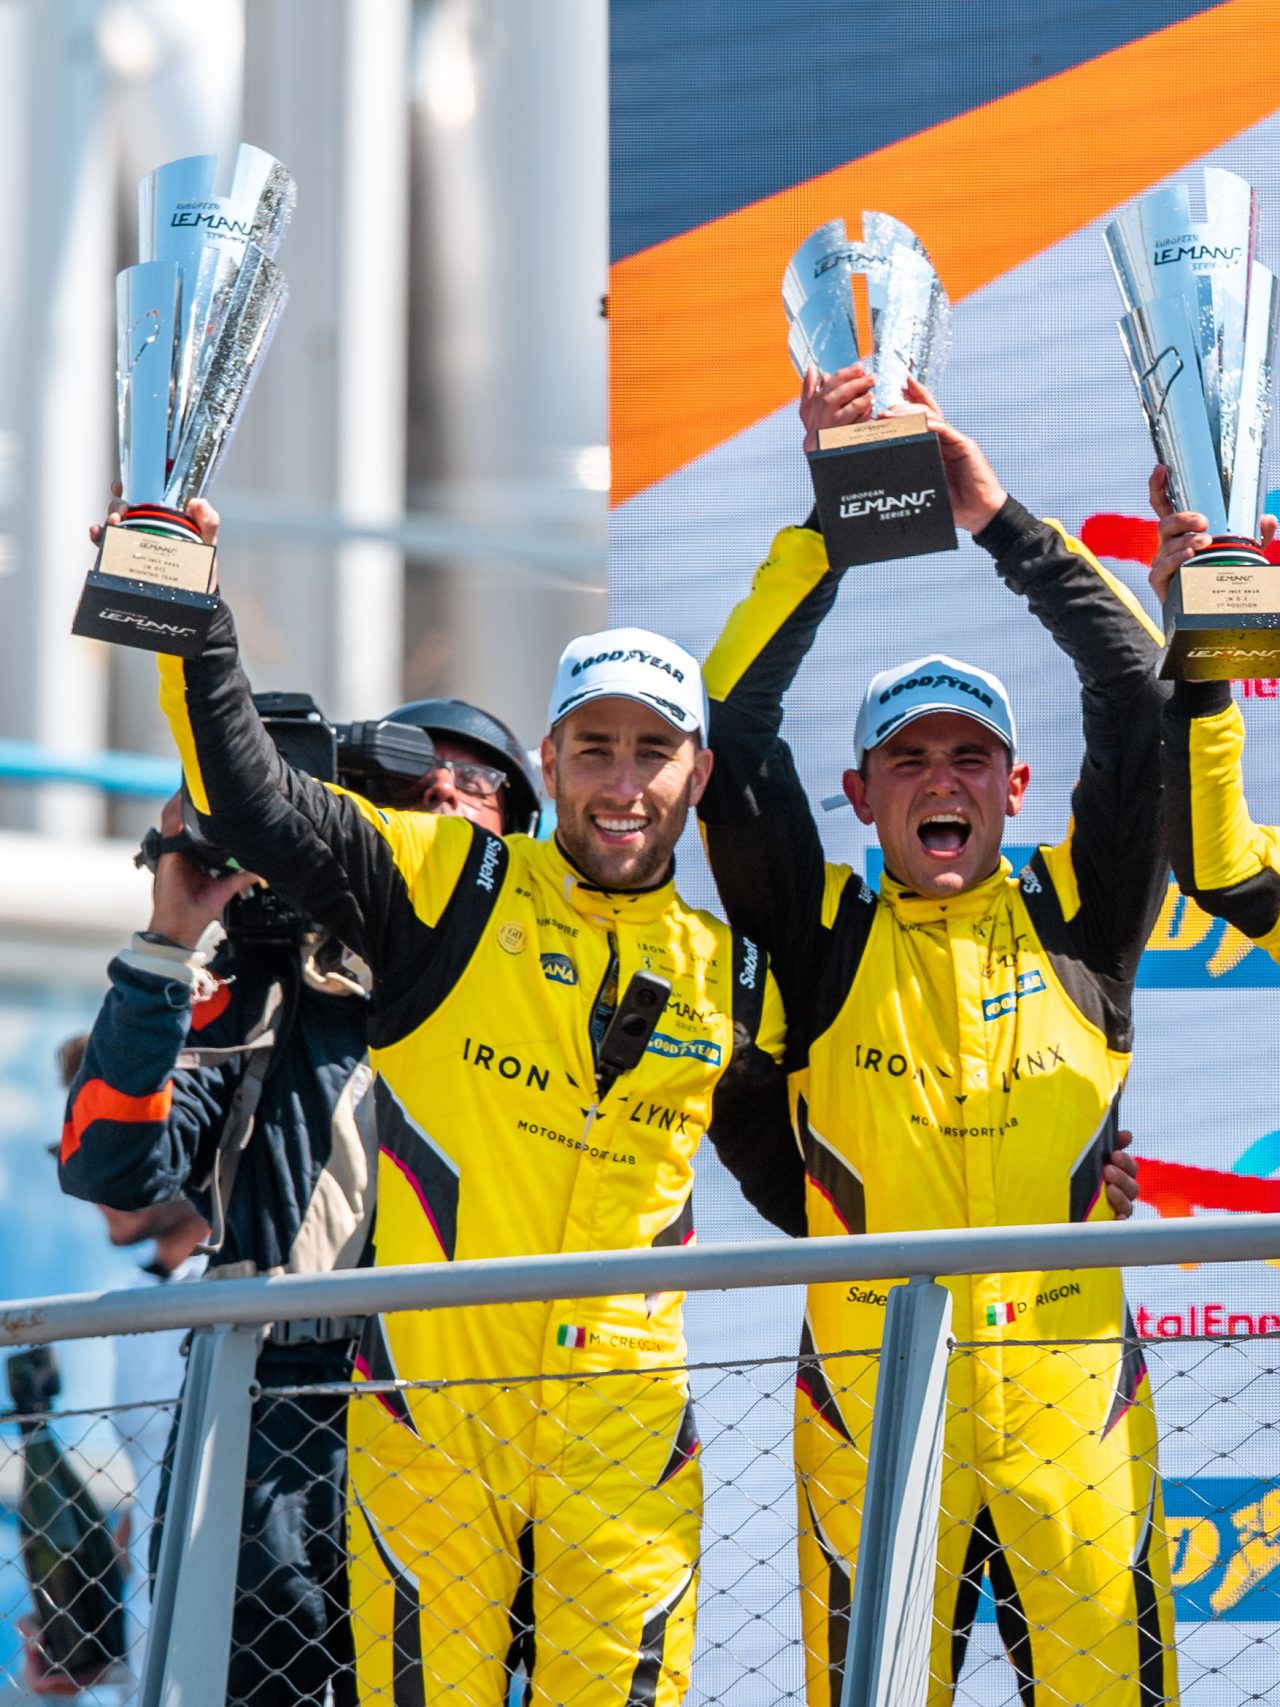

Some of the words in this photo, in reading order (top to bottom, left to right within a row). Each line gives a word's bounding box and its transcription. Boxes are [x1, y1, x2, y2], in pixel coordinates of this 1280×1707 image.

[840, 489, 885, 502] EUROPEAN
[879, 509, 911, 521] SERIES
[476, 836, 503, 894] Sabelt
[739, 936, 758, 990] Sabelt
[1002, 1043, 1066, 1093] LYNX
[463, 1038, 550, 1091] IRON
[630, 1101, 691, 1135] LYNX
[612, 1151, 637, 1165] LAB
[847, 1287, 887, 1307] Sabe
[1017, 1301, 1033, 1314] D.
[1036, 1283, 1081, 1308] RIGON
